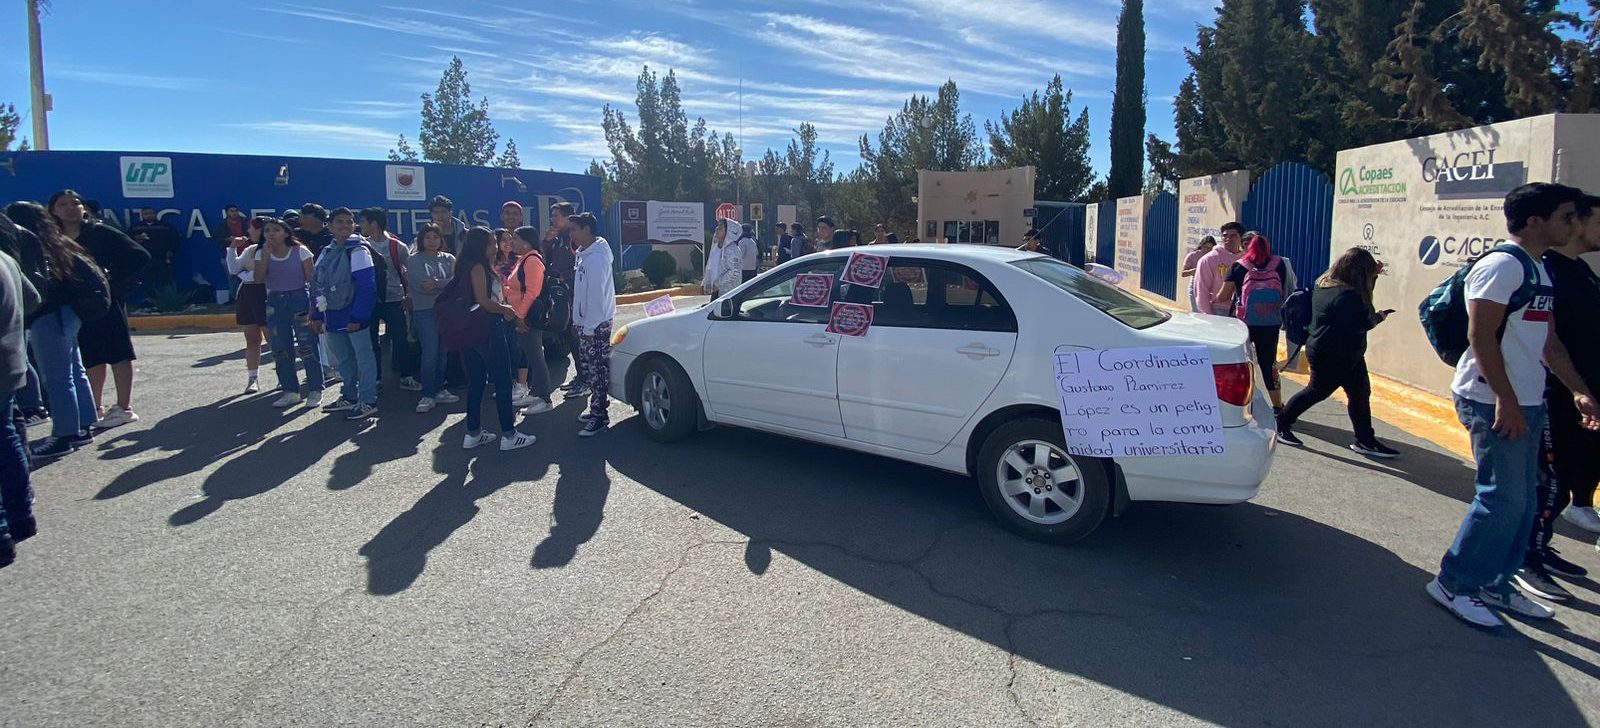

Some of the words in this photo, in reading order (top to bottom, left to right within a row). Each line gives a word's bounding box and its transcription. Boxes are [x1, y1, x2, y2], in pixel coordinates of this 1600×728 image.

[126, 162, 168, 183] UTP
[1360, 166, 1393, 183] Copaes
[1422, 147, 1496, 183] CACEI
[718, 209, 736, 220] ALTO
[1054, 352, 1081, 374] El
[1098, 350, 1209, 371] Coordinador
[1120, 403, 1141, 414] es
[1149, 403, 1168, 414] un
[1064, 427, 1088, 437] ro
[1101, 427, 1140, 442] para
[1150, 421, 1165, 436] la
[1069, 442, 1114, 456] nidad
[1124, 440, 1224, 456] universitario
